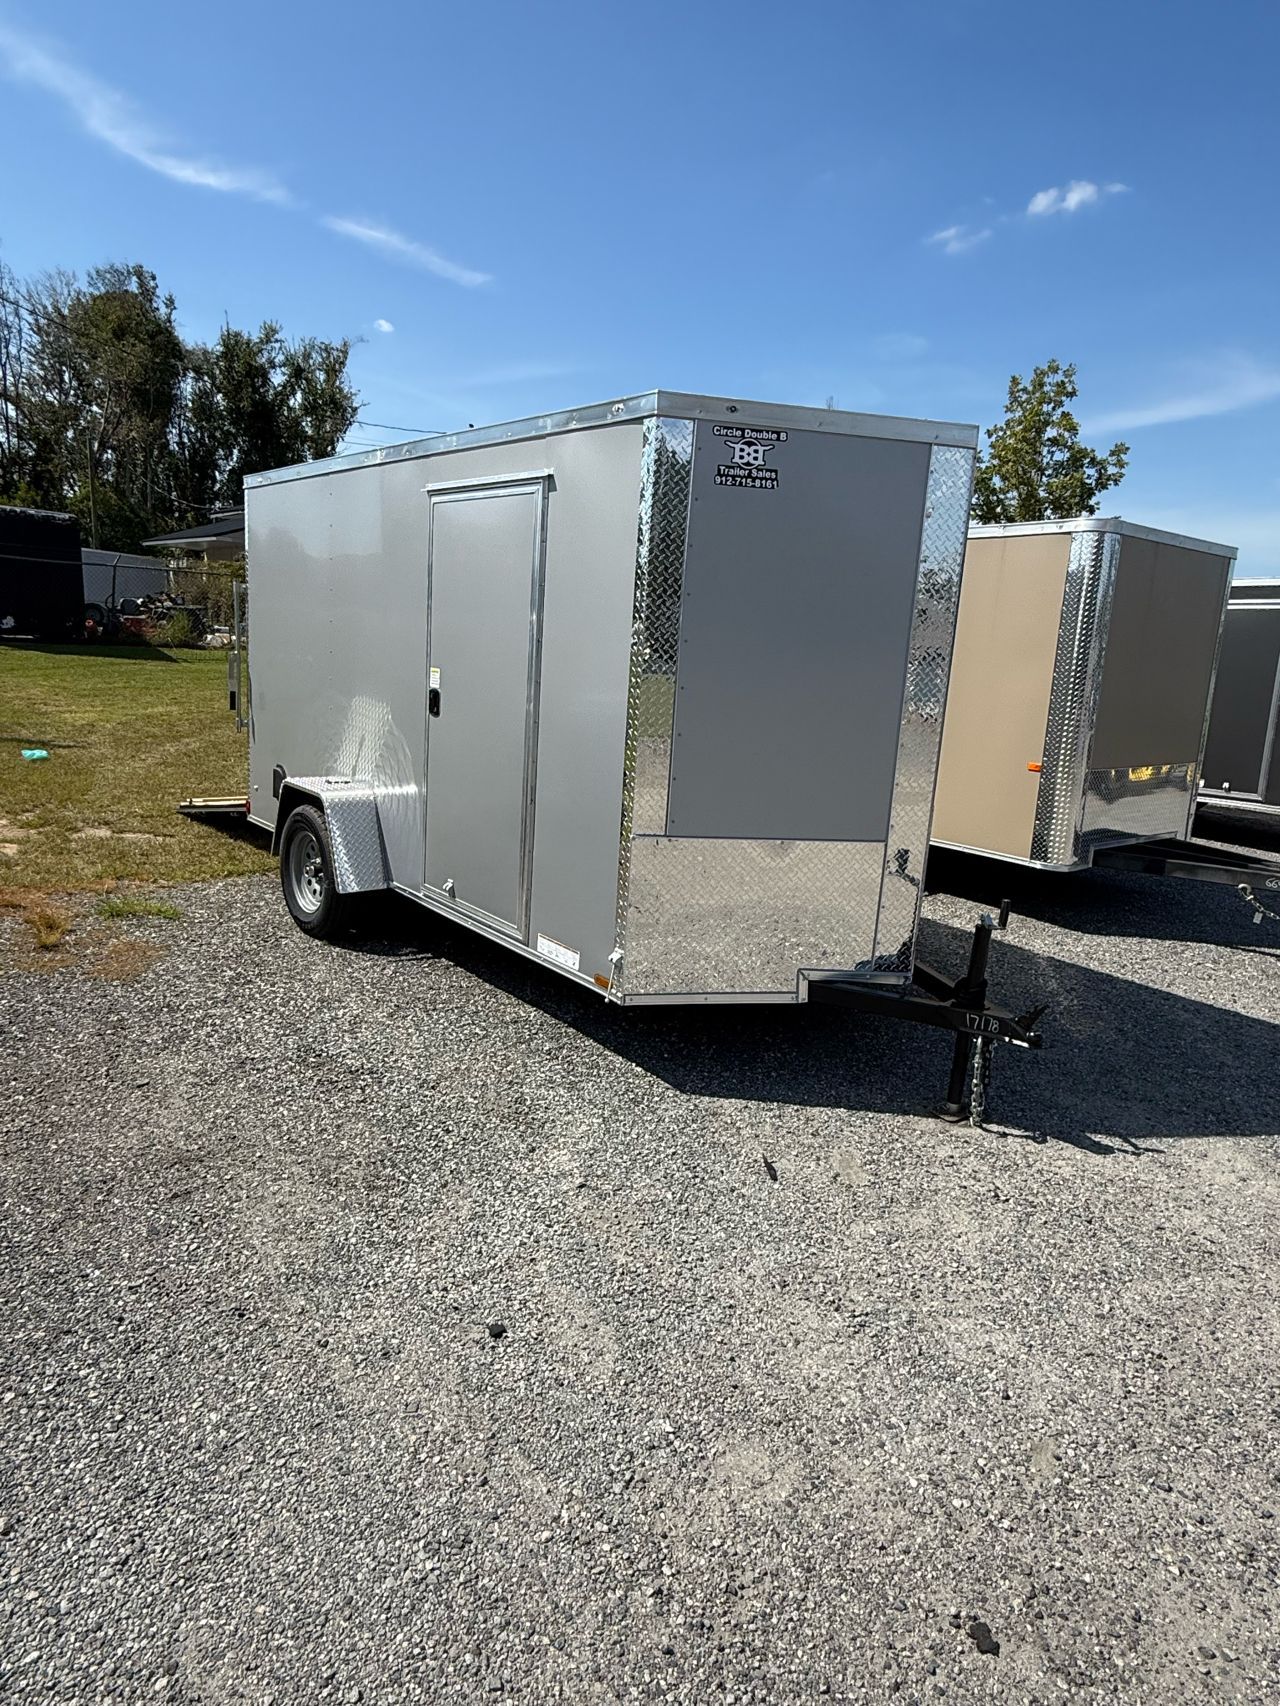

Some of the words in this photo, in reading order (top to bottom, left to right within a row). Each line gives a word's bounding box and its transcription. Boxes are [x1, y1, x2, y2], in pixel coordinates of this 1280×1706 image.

[713, 426, 742, 437] Circle
[744, 429, 778, 440] Double
[780, 432, 787, 441] B
[719, 466, 749, 476] Trailer
[751, 469, 776, 479] Sales
[715, 475, 778, 489] 912-715-8161
